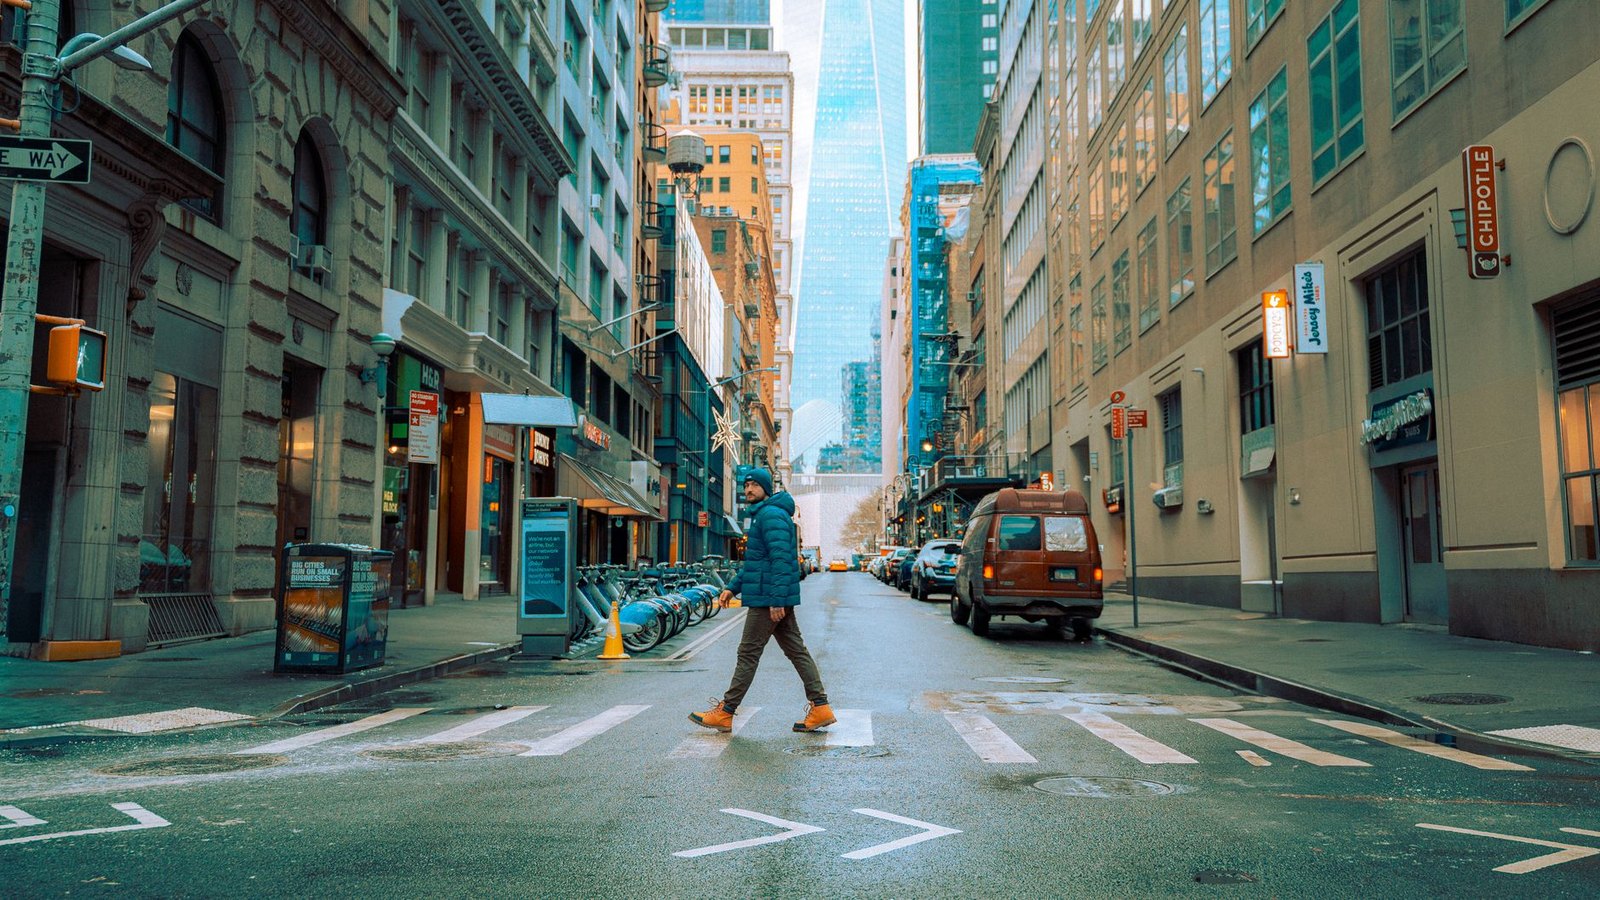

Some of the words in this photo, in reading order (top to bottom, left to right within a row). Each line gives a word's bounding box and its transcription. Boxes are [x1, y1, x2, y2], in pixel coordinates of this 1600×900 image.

[29, 151, 69, 169] WAY
[1474, 151, 1494, 247] CHIPOTLE
[1302, 271, 1315, 305] Mike's
[1309, 308, 1321, 345] Jersey
[422, 363, 440, 390] H&R
[534, 430, 550, 450] JIMMY
[383, 501, 397, 512] BLOCK
[291, 561, 303, 569] BIG
[304, 561, 325, 569] CITIES
